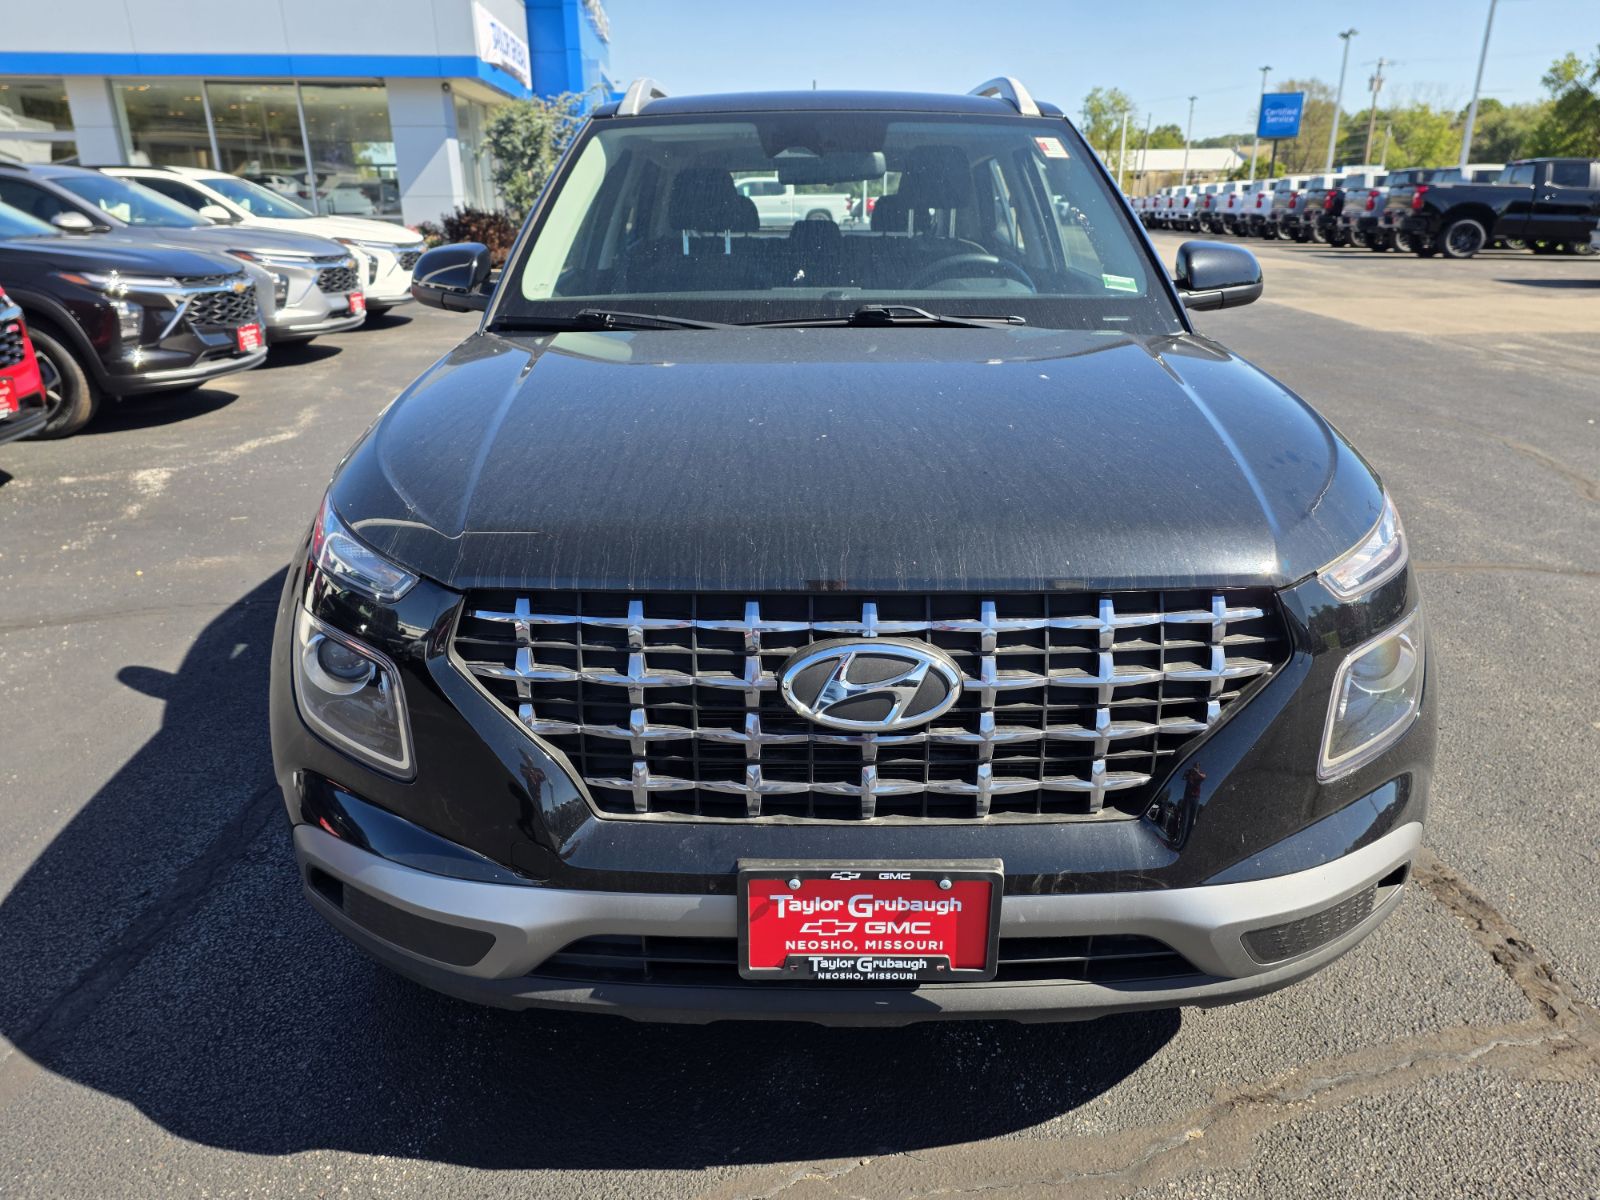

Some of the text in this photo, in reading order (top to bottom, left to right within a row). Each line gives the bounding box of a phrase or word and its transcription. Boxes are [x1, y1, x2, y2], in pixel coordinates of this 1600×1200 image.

[878, 872, 911, 880] GMC
[769, 893, 962, 918] Taylor Grubaugh
[864, 921, 931, 935] GMC
[785, 940, 944, 951] NEOSHO, MISSOURI
[808, 956, 927, 972] Taylor Grubaugh
[817, 972, 917, 981] NEOSHO, MISSOURI
